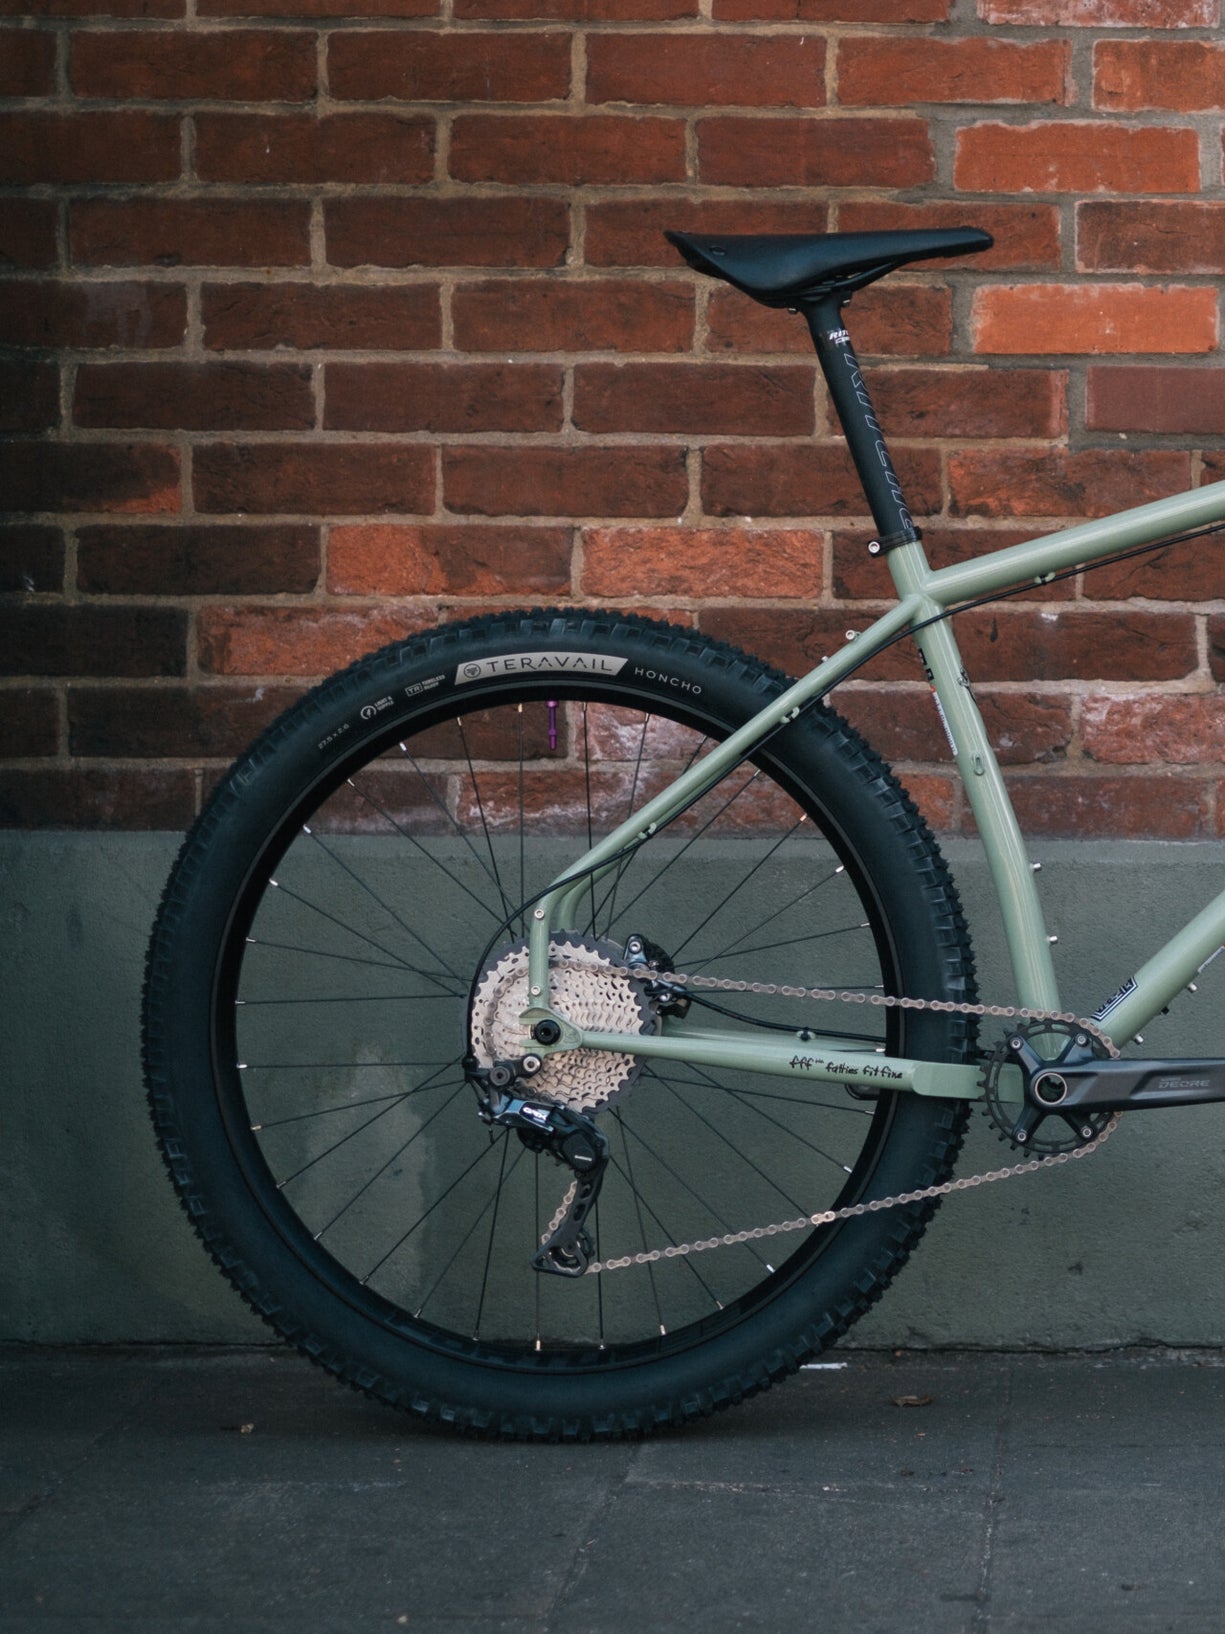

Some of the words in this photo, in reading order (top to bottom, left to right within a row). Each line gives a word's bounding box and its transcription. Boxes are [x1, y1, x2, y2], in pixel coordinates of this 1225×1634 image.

[486, 656, 613, 672] TERAVAIL
[634, 666, 702, 695] HONCHO
[825, 1061, 859, 1074] fatties
[862, 1065, 879, 1076] fit
[879, 1065, 903, 1079] fine
